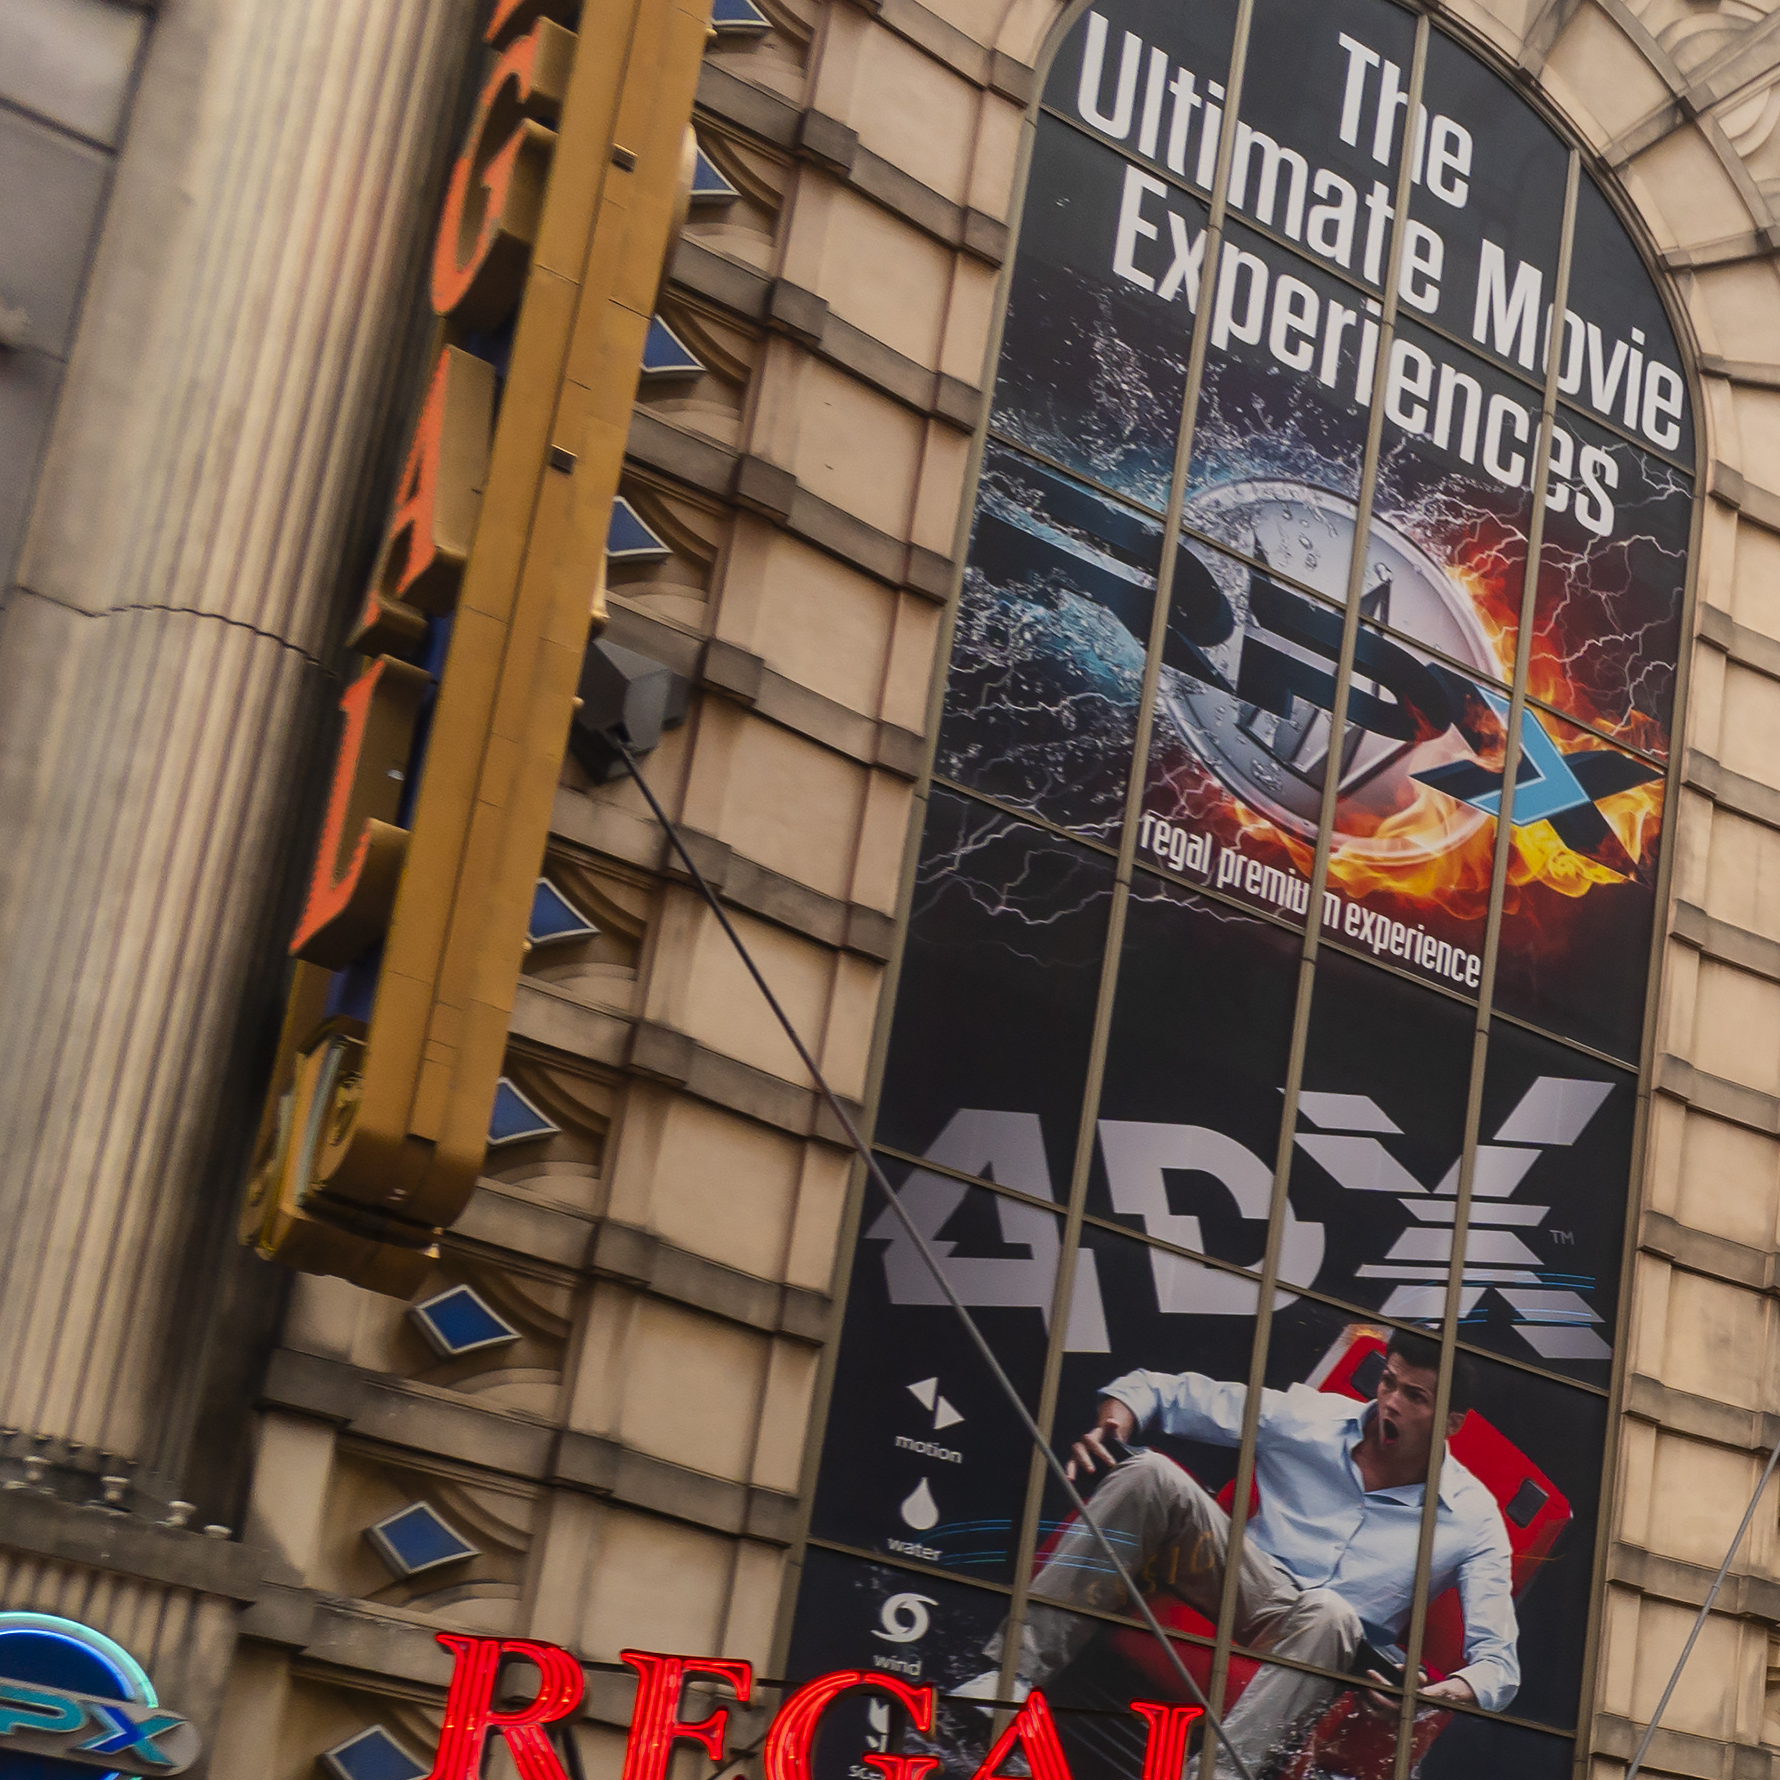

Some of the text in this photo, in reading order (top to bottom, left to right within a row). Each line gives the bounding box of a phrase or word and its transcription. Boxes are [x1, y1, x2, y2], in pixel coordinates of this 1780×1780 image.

[1338, 32, 1473, 210] The
[1077, 9, 1685, 453] Ultimate Movie
[1112, 163, 1620, 539] Experiences
[1138, 809, 1483, 990] regal premium experience
[895, 1435, 963, 1464] motion
[887, 1538, 943, 1561] water
[873, 1654, 923, 1677] wind
